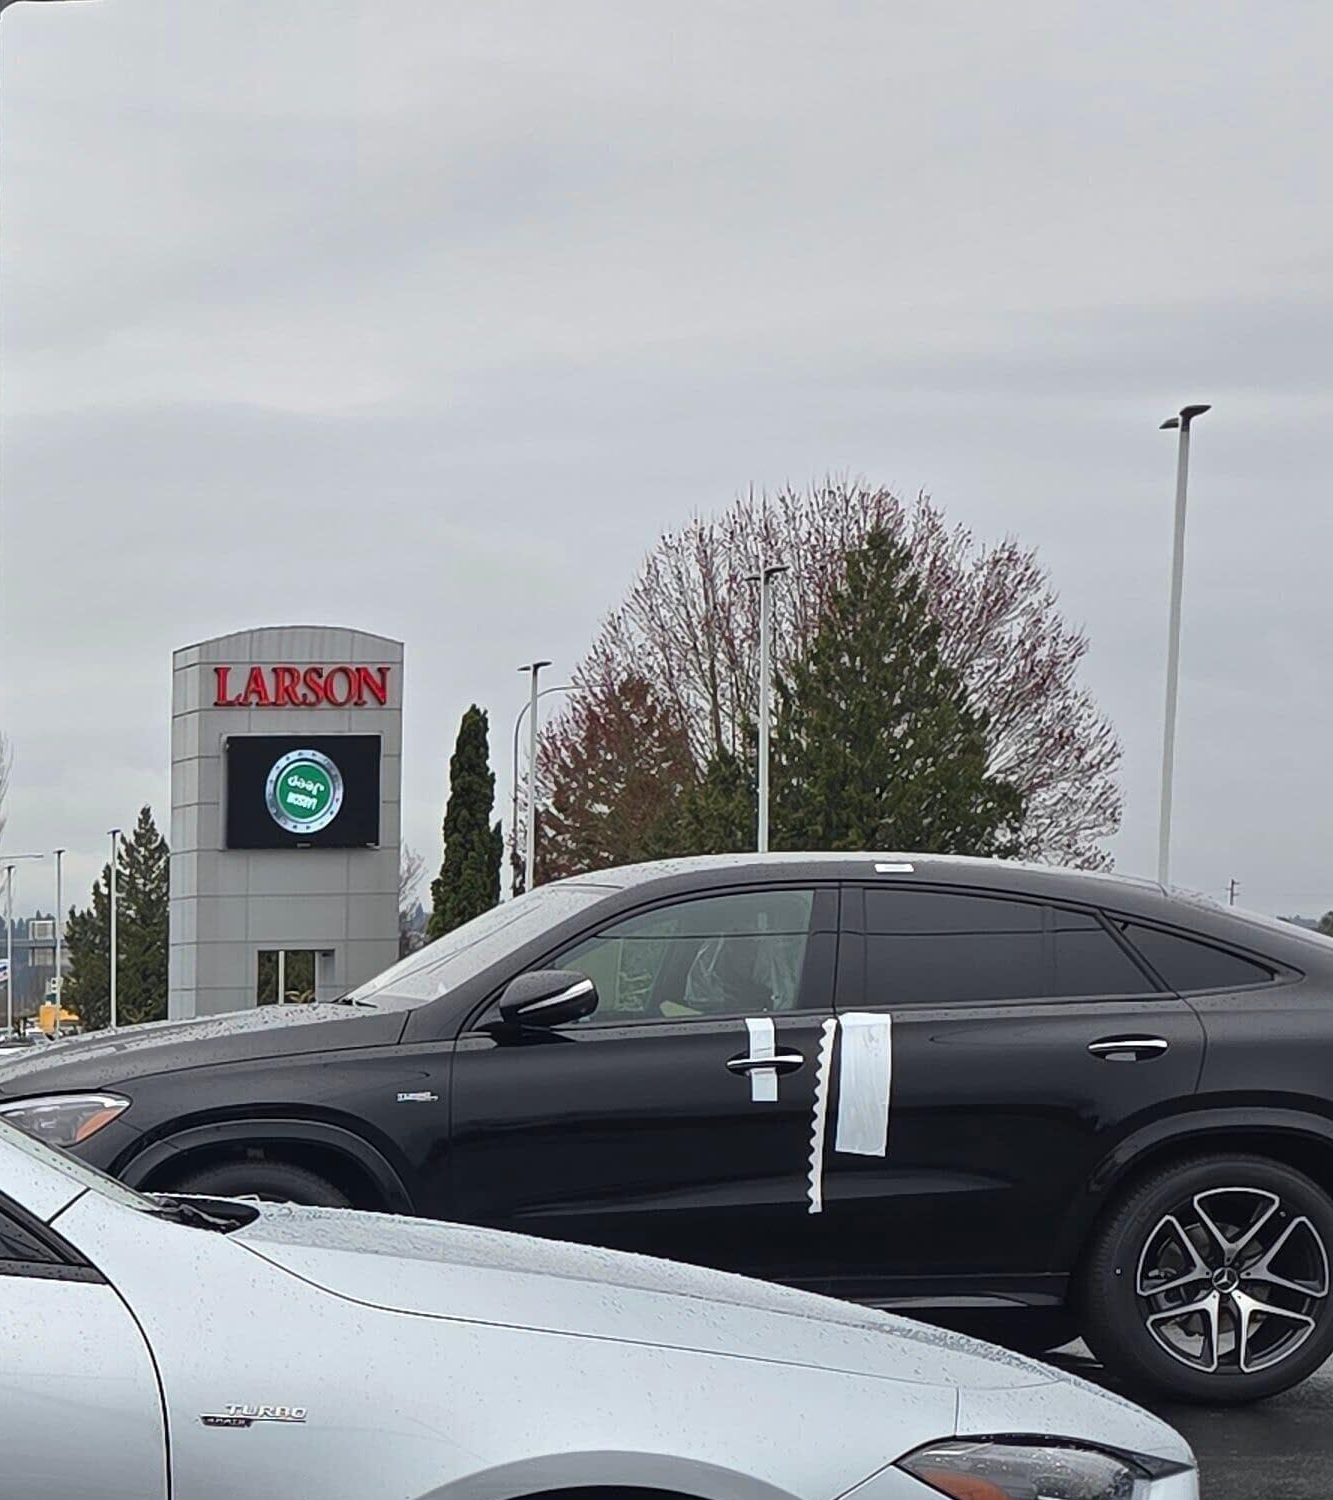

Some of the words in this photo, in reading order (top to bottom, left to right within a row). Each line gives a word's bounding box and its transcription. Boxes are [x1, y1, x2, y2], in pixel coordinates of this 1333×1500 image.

[213, 667, 390, 707] LARSON
[287, 775, 324, 795] Jeep
[226, 1403, 308, 1418] TURBO
